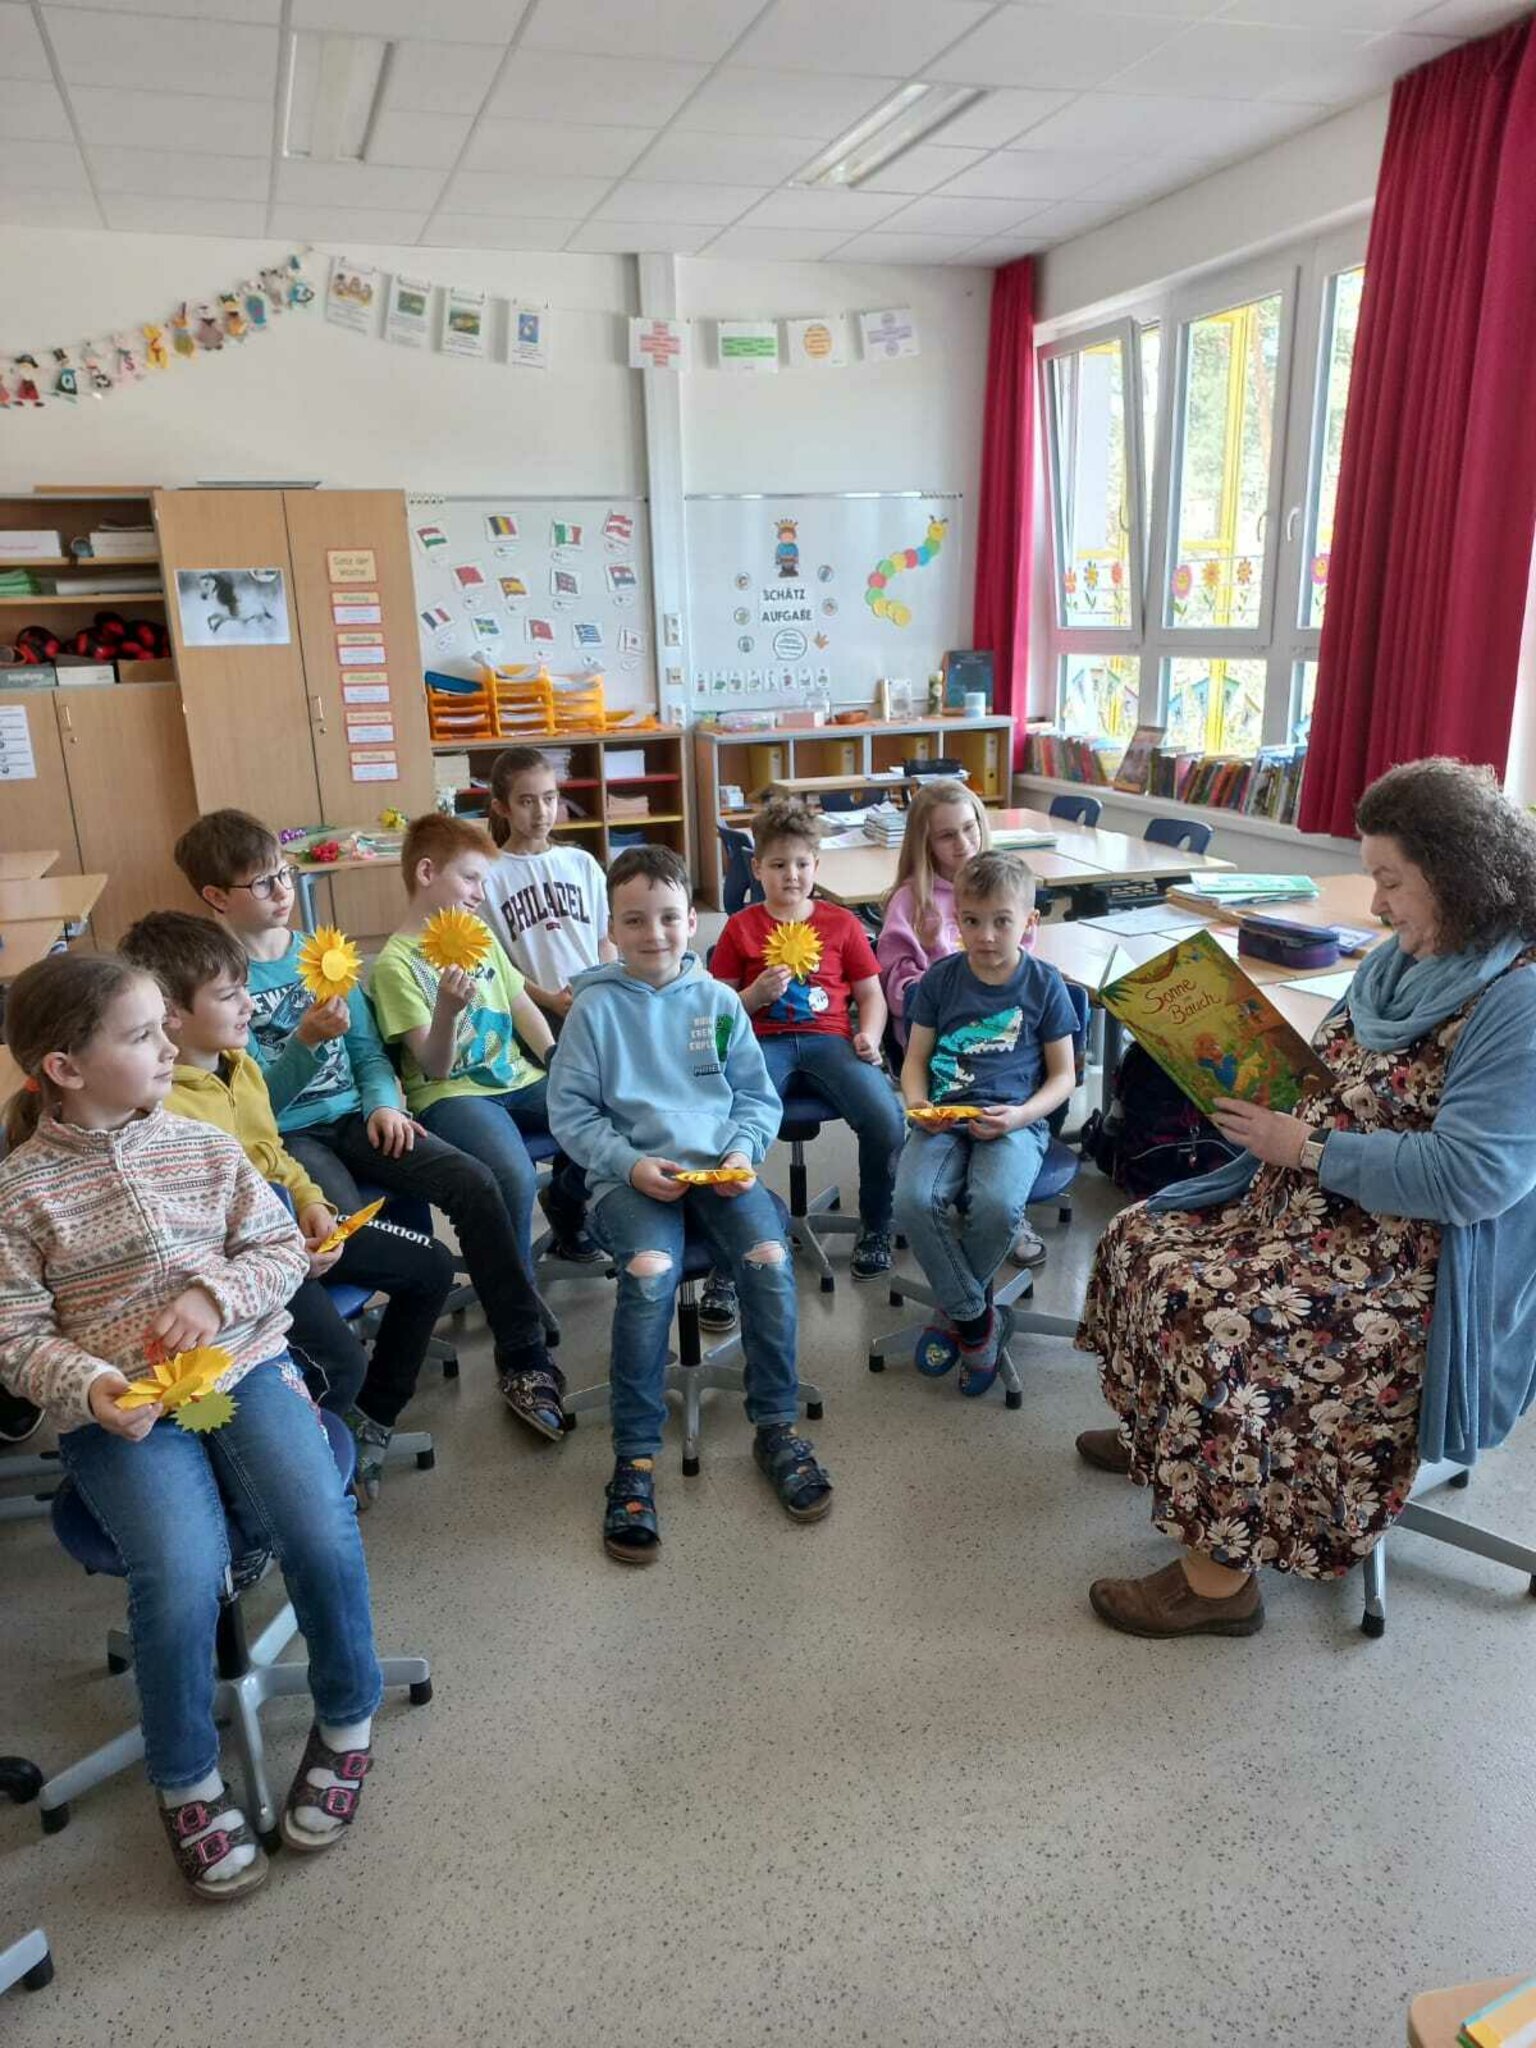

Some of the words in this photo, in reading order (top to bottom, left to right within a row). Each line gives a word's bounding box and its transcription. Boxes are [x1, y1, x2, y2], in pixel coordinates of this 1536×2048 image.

[762, 609, 812, 622] AUFGABE
[500, 881, 591, 942] PHILADEL
[1141, 978, 1198, 1015] Sonne
